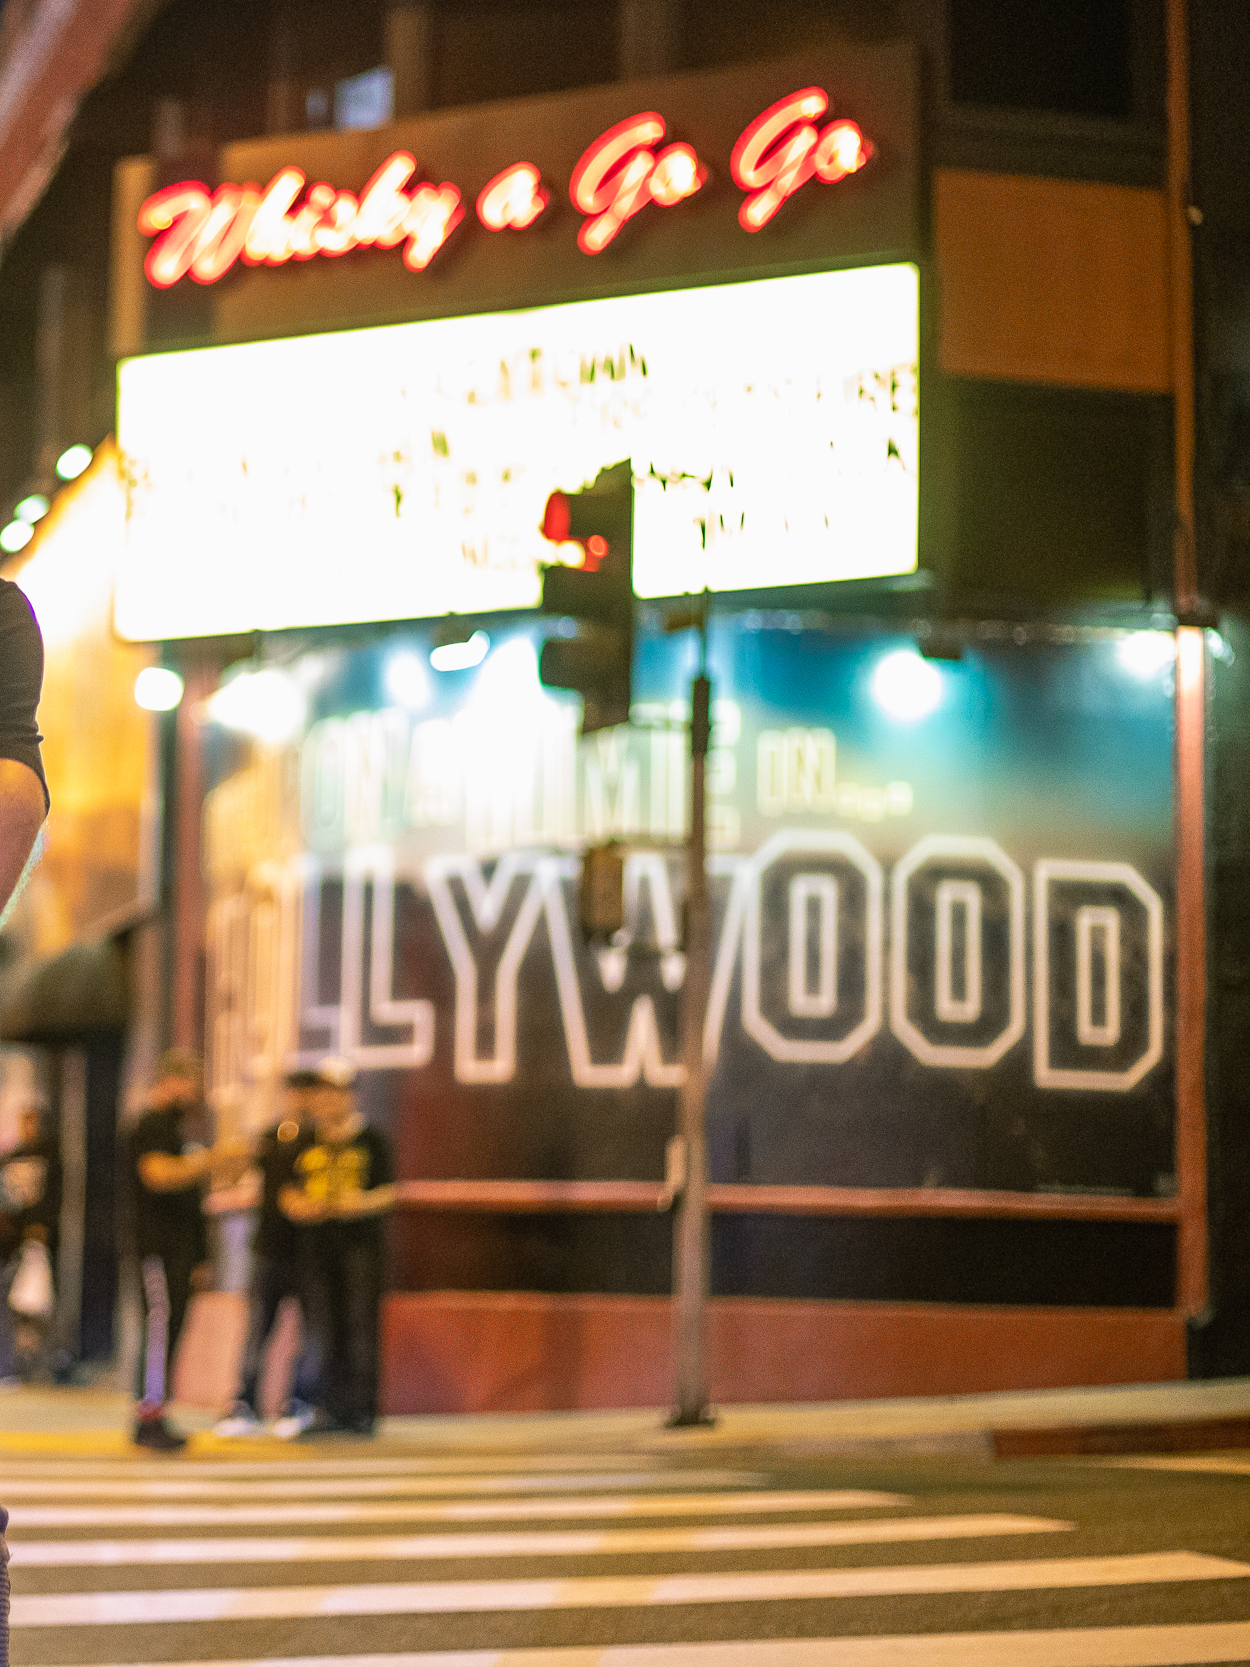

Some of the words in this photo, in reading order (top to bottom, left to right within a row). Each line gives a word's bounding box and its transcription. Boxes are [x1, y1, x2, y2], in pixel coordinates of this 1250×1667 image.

[138, 150, 461, 290] Whisky
[477, 161, 547, 231] a
[569, 110, 702, 256] Go
[731, 85, 874, 233] Go
